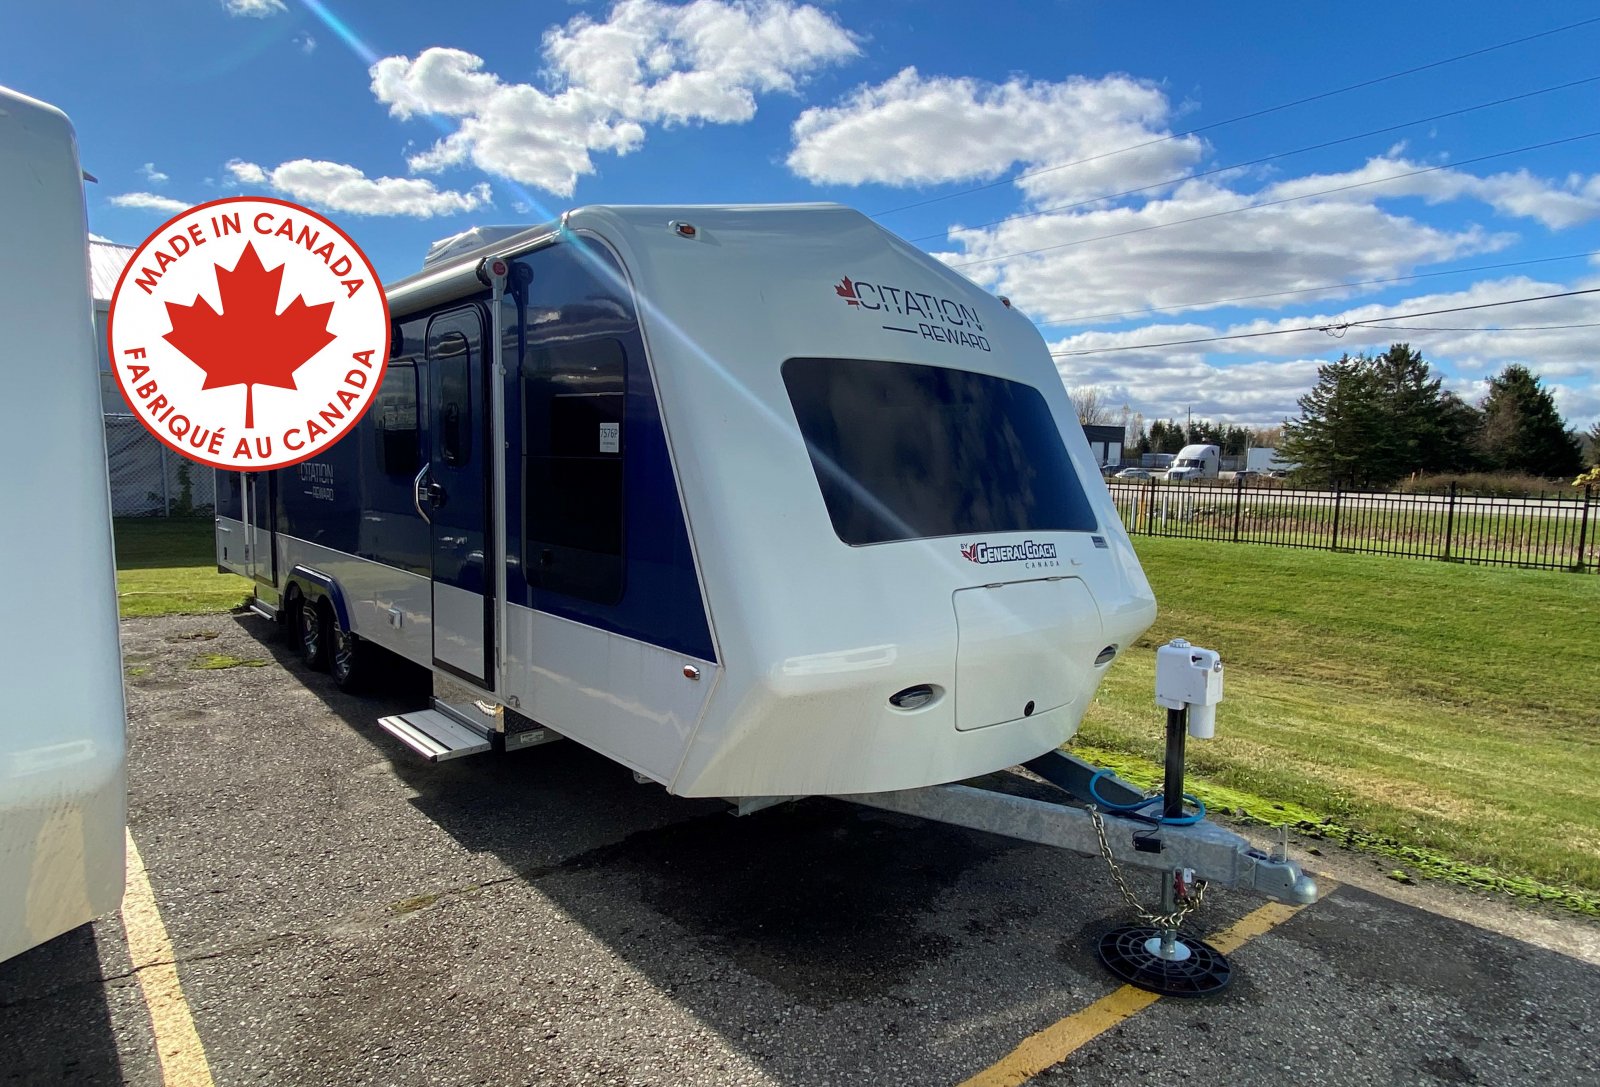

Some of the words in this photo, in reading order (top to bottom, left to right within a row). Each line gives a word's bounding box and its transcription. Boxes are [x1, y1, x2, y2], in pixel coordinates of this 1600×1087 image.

[855, 282, 983, 332] CITATION
[919, 323, 991, 352] REWARD
[301, 462, 333, 485] CITATION
[976, 542, 1027, 564] GENERAL
[1024, 540, 1057, 560] COACH
[1025, 561, 1060, 569] CANADA
